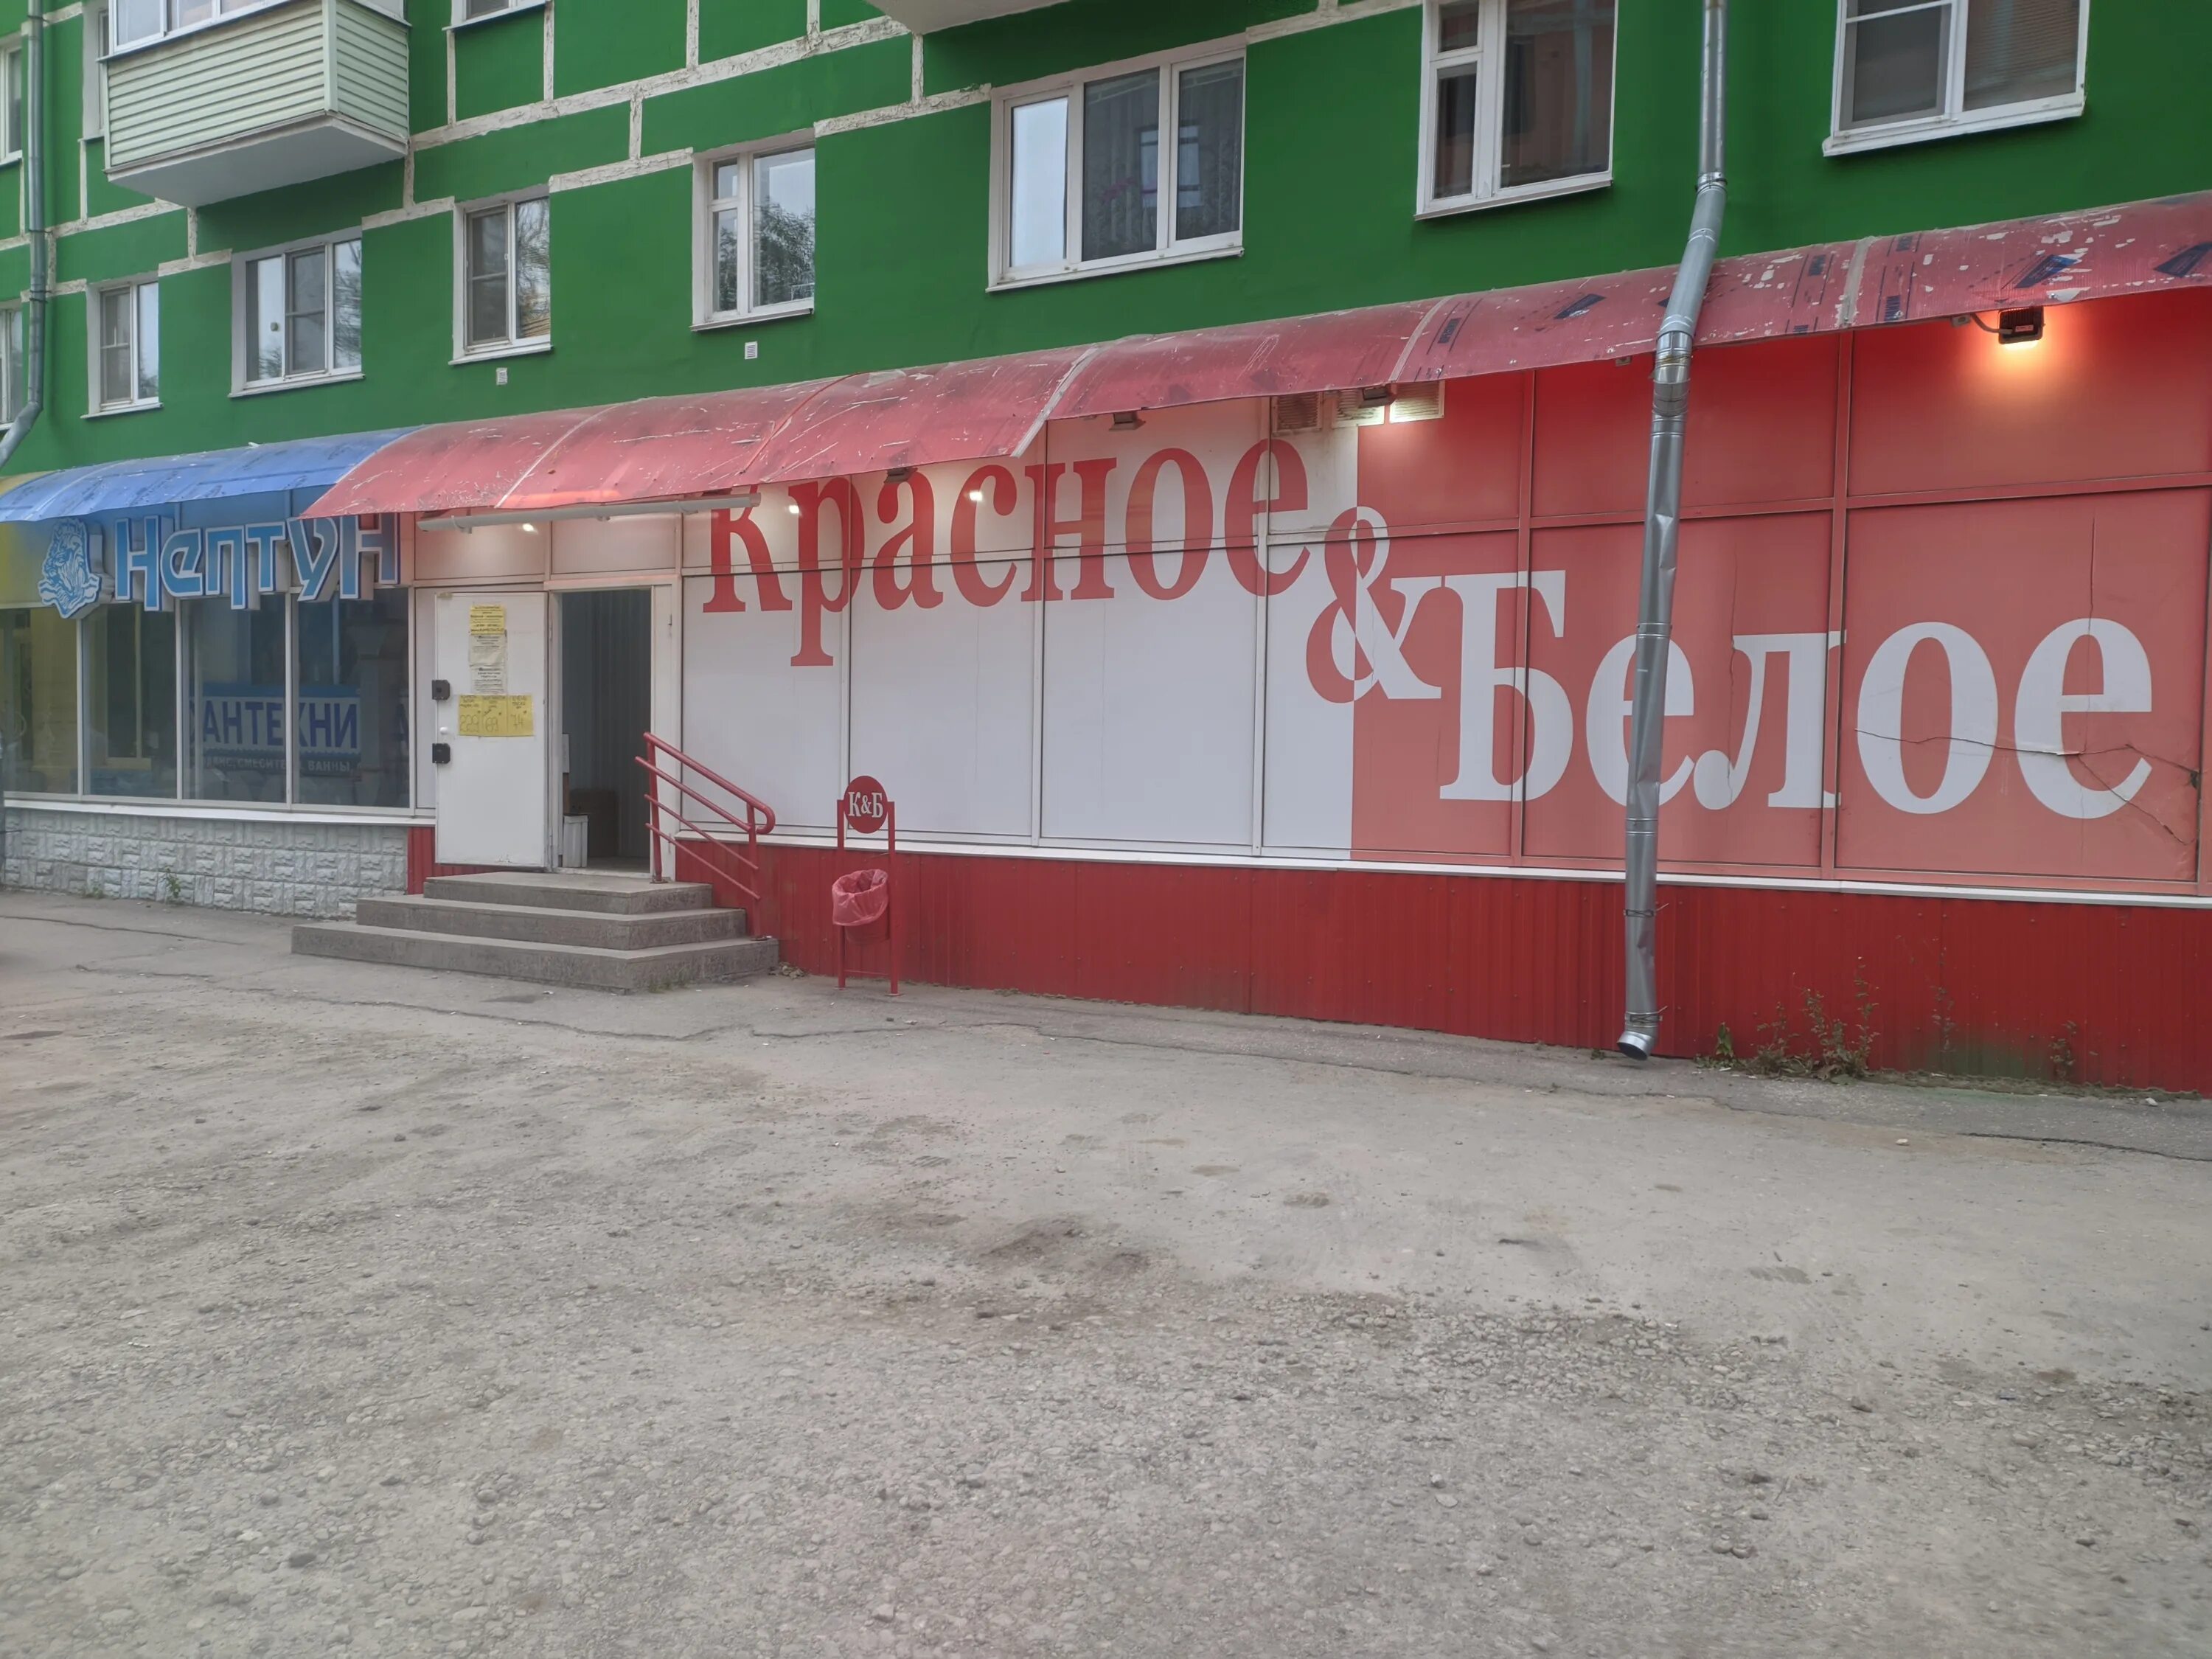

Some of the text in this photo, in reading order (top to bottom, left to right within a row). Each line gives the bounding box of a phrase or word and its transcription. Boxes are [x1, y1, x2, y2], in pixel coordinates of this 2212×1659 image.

[115, 512, 401, 611] Нептун
[702, 438, 1310, 667] Красное
[1306, 507, 1441, 703] &
[1439, 570, 2153, 819] Белое
